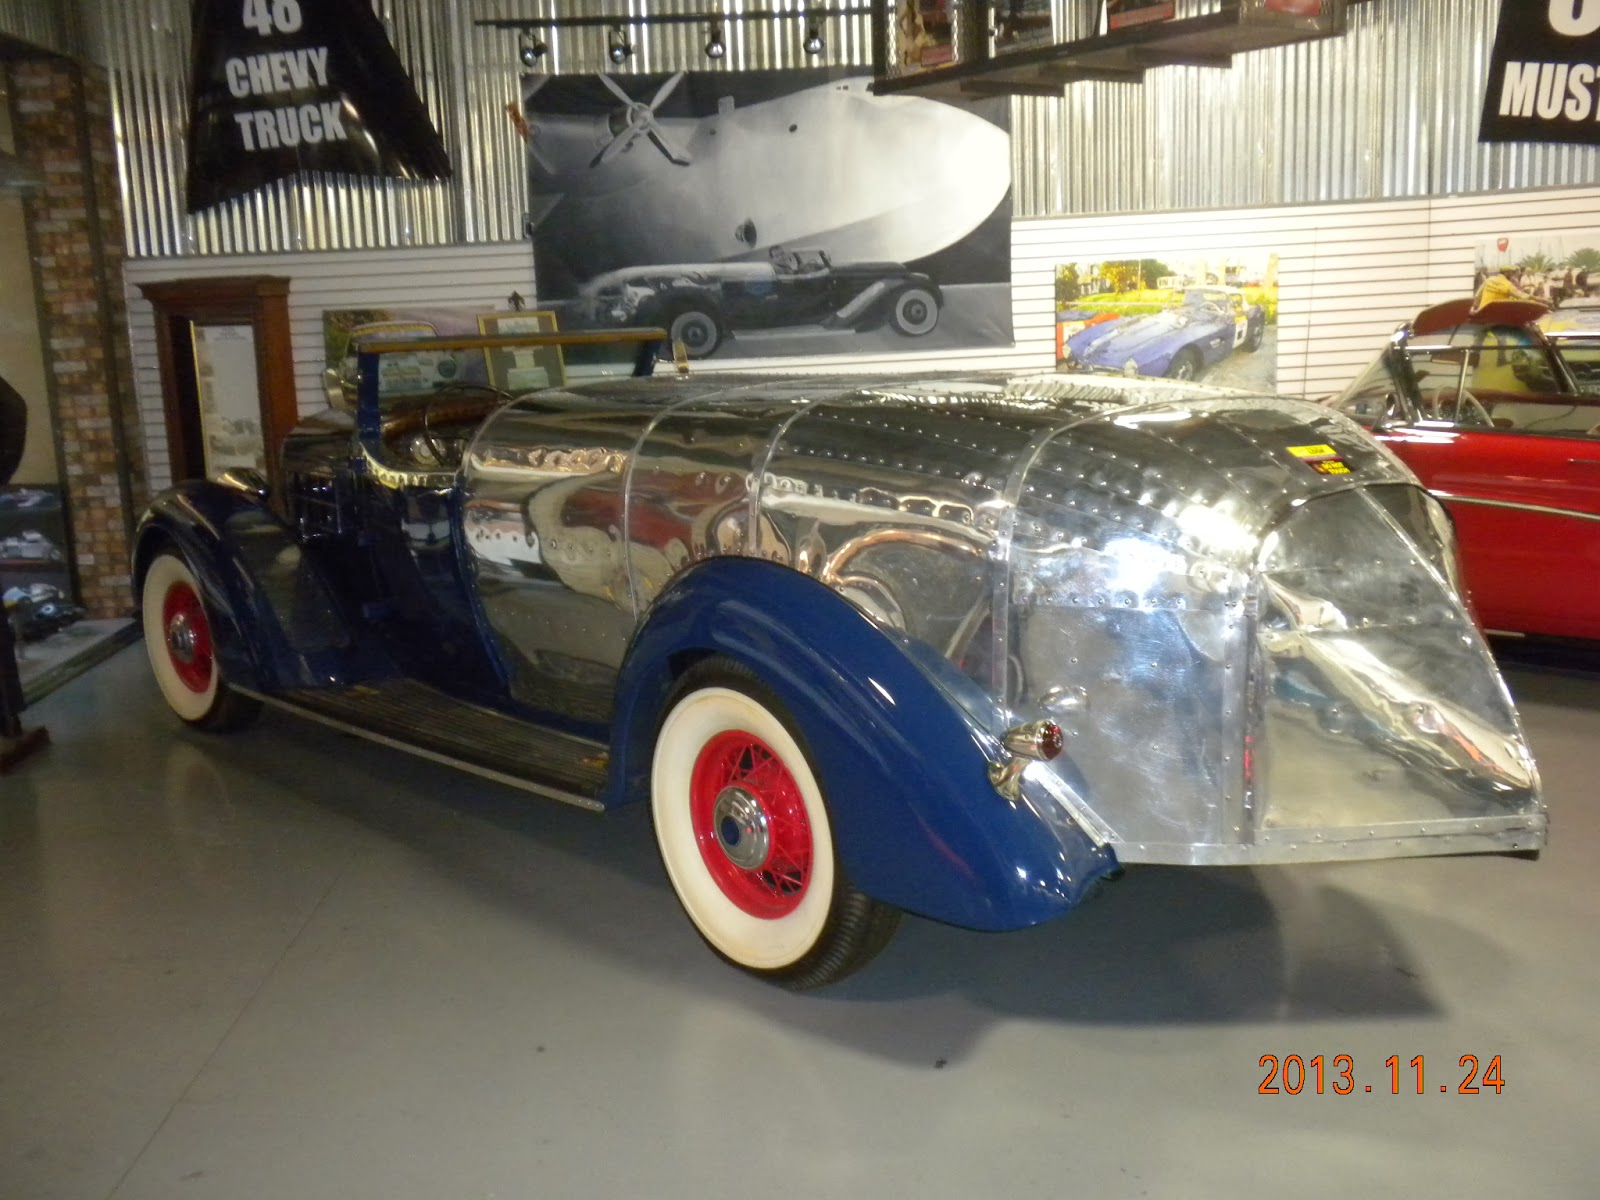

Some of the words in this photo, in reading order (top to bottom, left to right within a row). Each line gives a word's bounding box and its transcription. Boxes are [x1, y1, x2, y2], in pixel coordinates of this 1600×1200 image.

[225, 47, 328, 98] CHEVY
[1498, 61, 1600, 122] MUS
[233, 101, 347, 151] TRUCK
